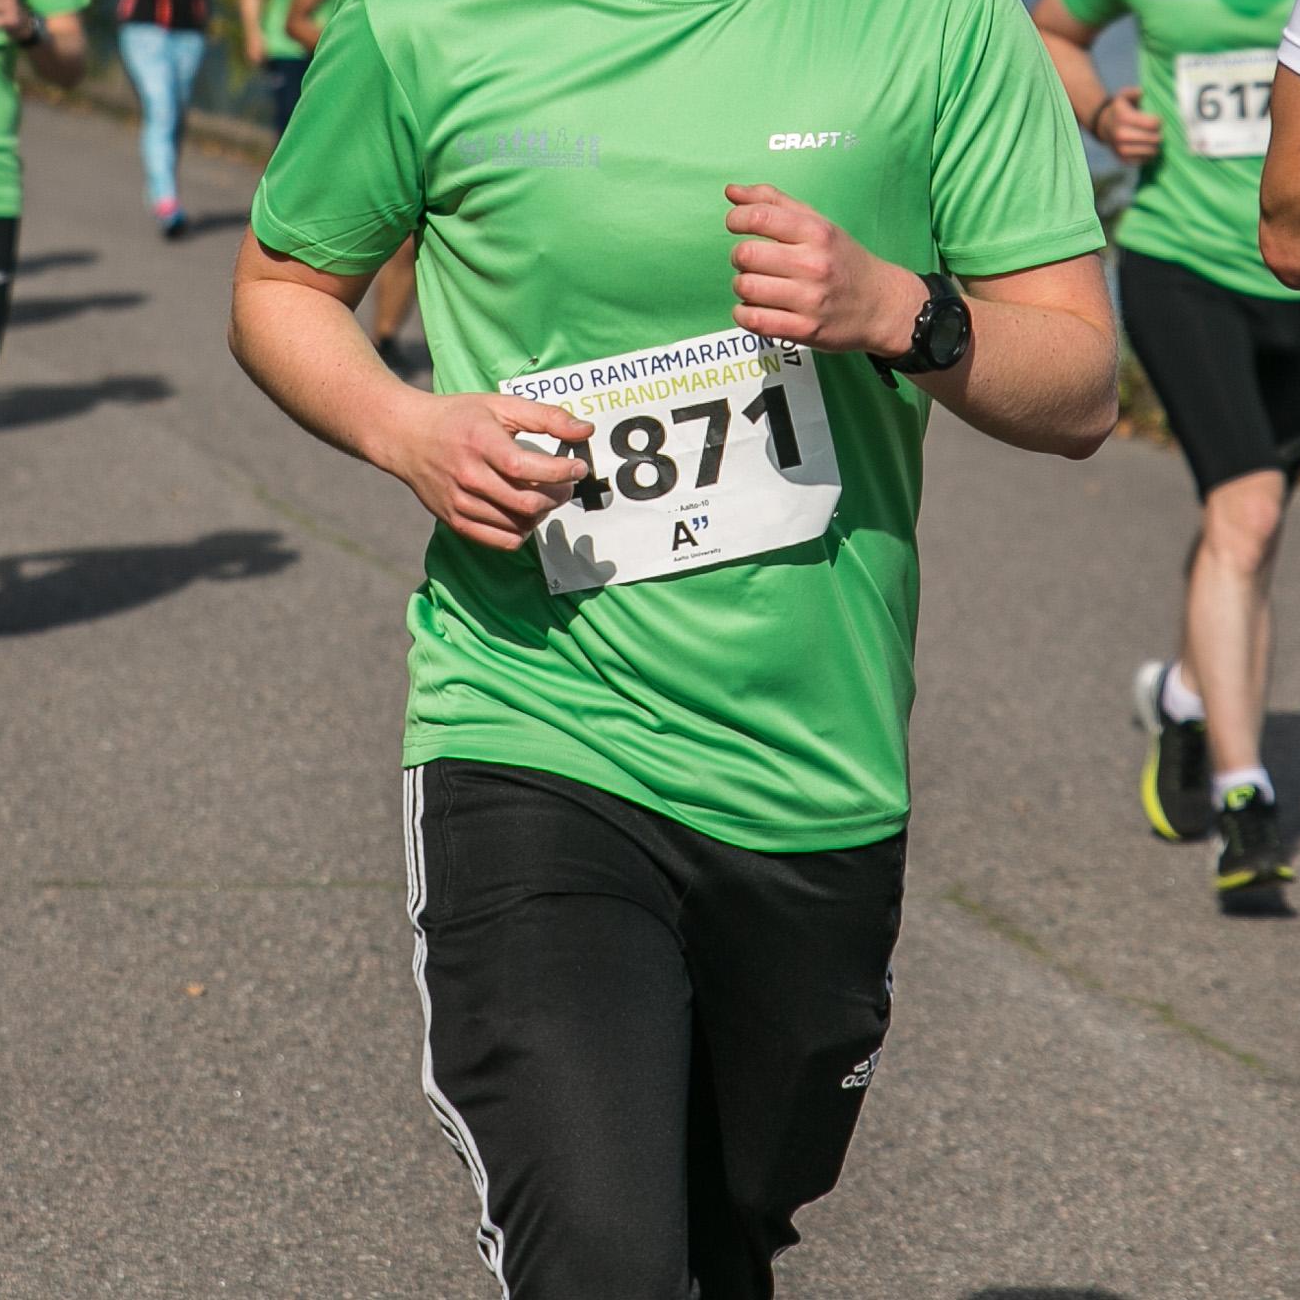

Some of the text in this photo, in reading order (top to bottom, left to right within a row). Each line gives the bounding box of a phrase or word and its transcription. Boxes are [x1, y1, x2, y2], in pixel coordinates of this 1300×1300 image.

[1196, 81, 1273, 121] 617
[767, 131, 842, 152] CRAFT
[512, 334, 776, 402] ESPOO RANTAMARATON
[780, 337, 802, 367] 017
[580, 353, 781, 416] STRANDMARATON
[554, 384, 803, 513] 4871
